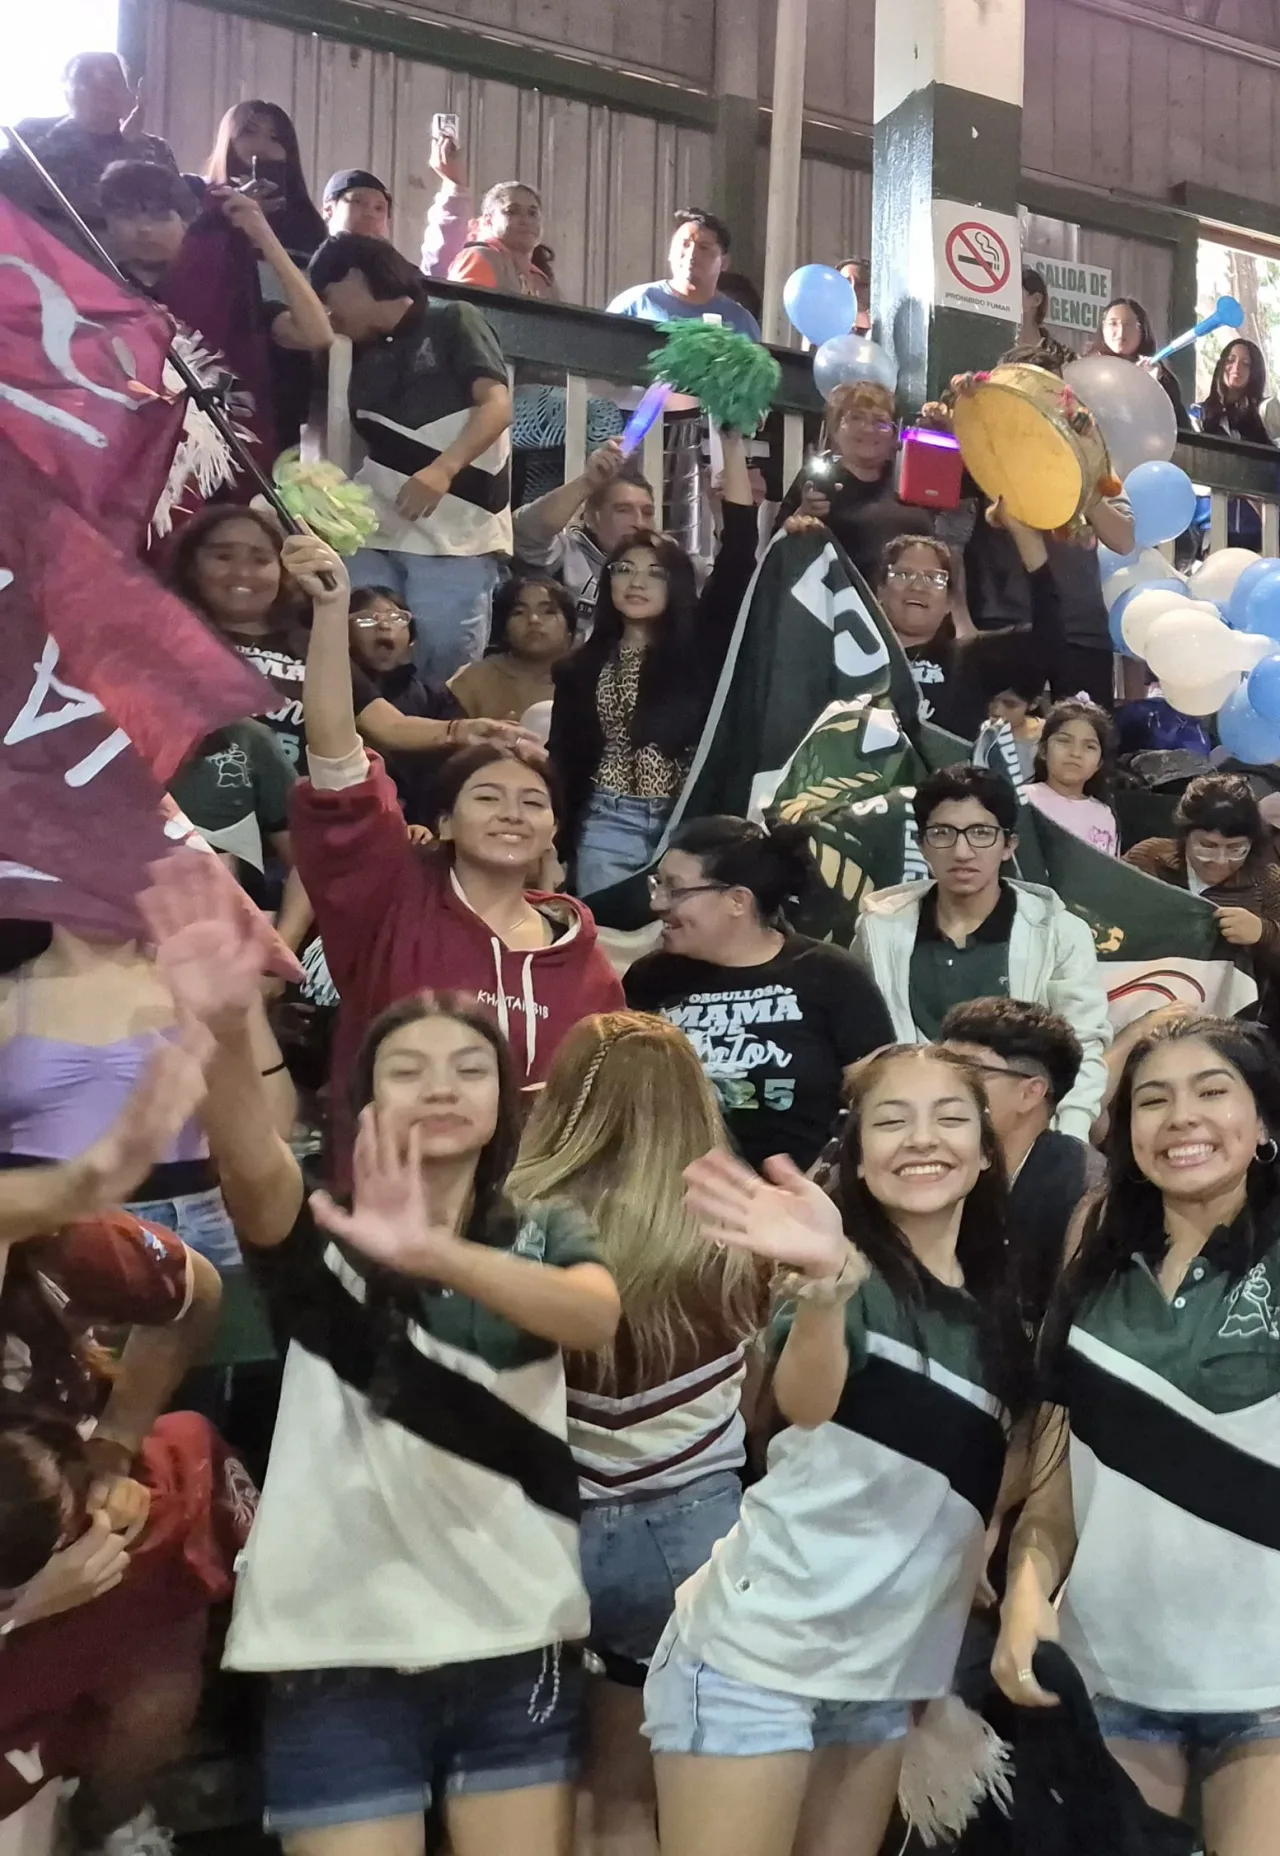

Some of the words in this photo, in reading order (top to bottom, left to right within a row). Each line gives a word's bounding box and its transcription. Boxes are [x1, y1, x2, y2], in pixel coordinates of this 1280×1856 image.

[1090, 272, 1107, 298] DE
[945, 291, 985, 306] PROHIBIDO
[986, 301, 1011, 312] FUMAR
[1050, 296, 1099, 329] GENCI
[476, 989, 549, 1019] KHTASIS
